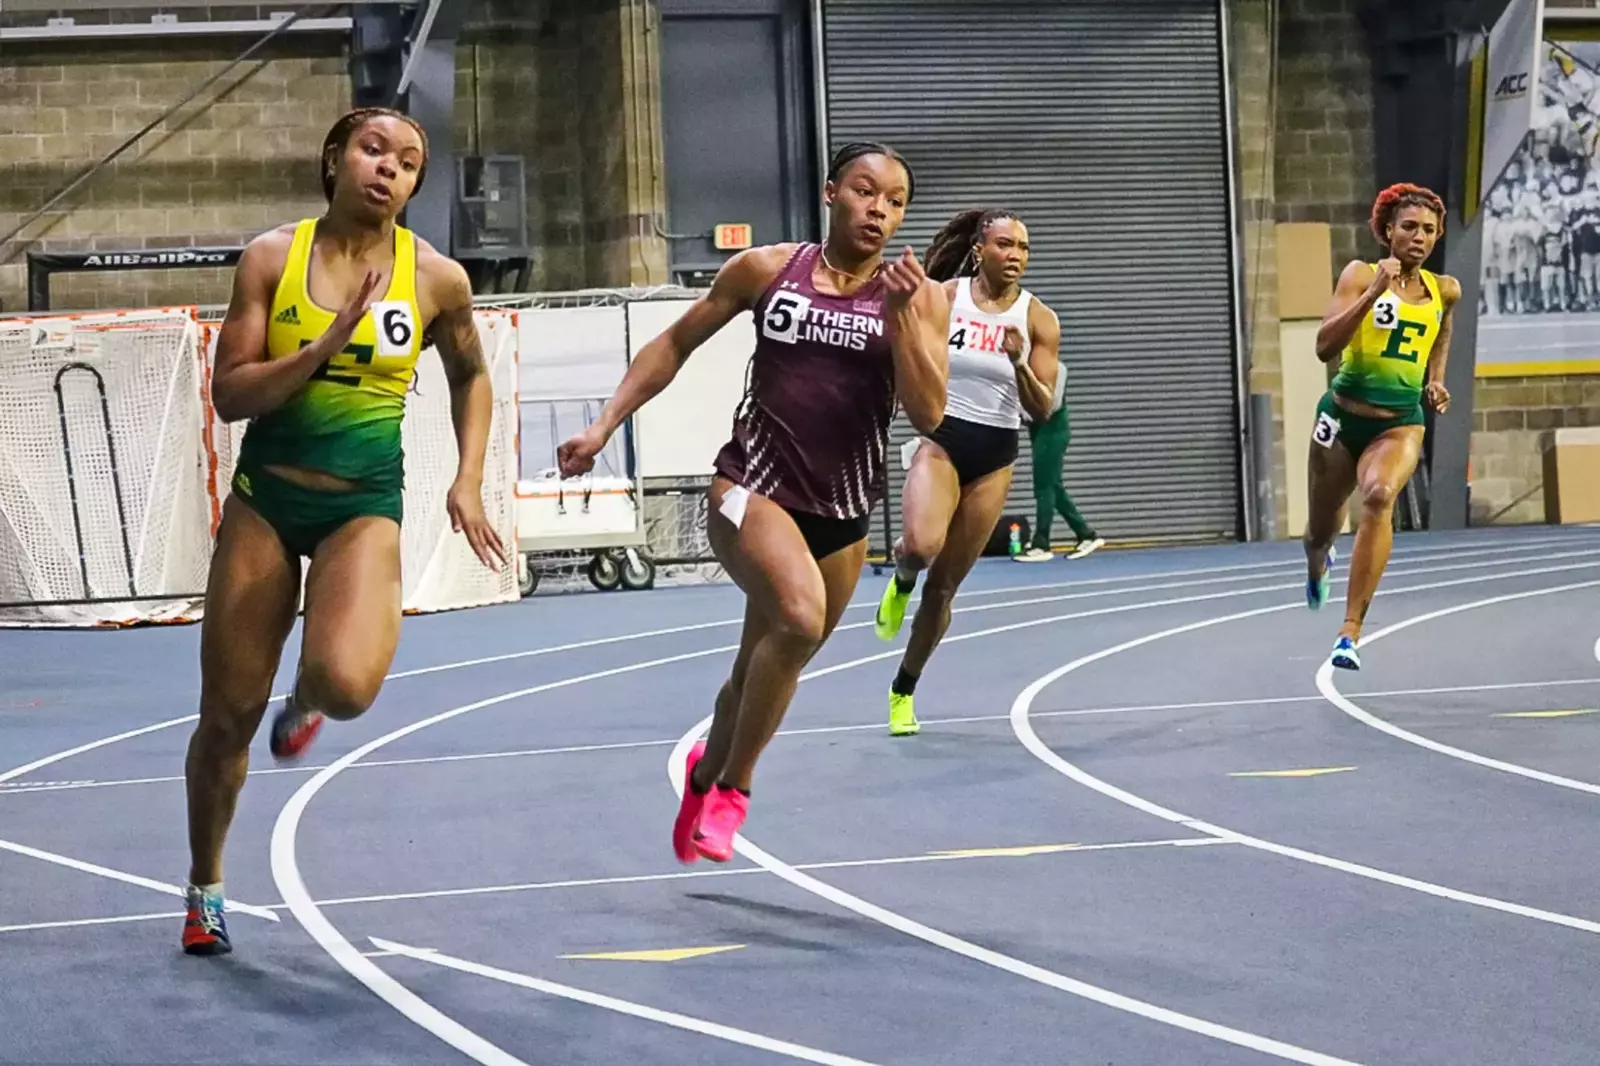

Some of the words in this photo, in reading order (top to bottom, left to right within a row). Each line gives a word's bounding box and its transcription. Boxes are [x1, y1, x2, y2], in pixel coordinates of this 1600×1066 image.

[1495, 72, 1528, 95] ACC
[767, 297, 799, 333] 5
[805, 307, 883, 336] THERN
[1376, 303, 1394, 325] 3
[383, 309, 411, 346] 6
[948, 328, 966, 350] 4
[1380, 319, 1427, 363] E
[1316, 420, 1332, 442] 3
